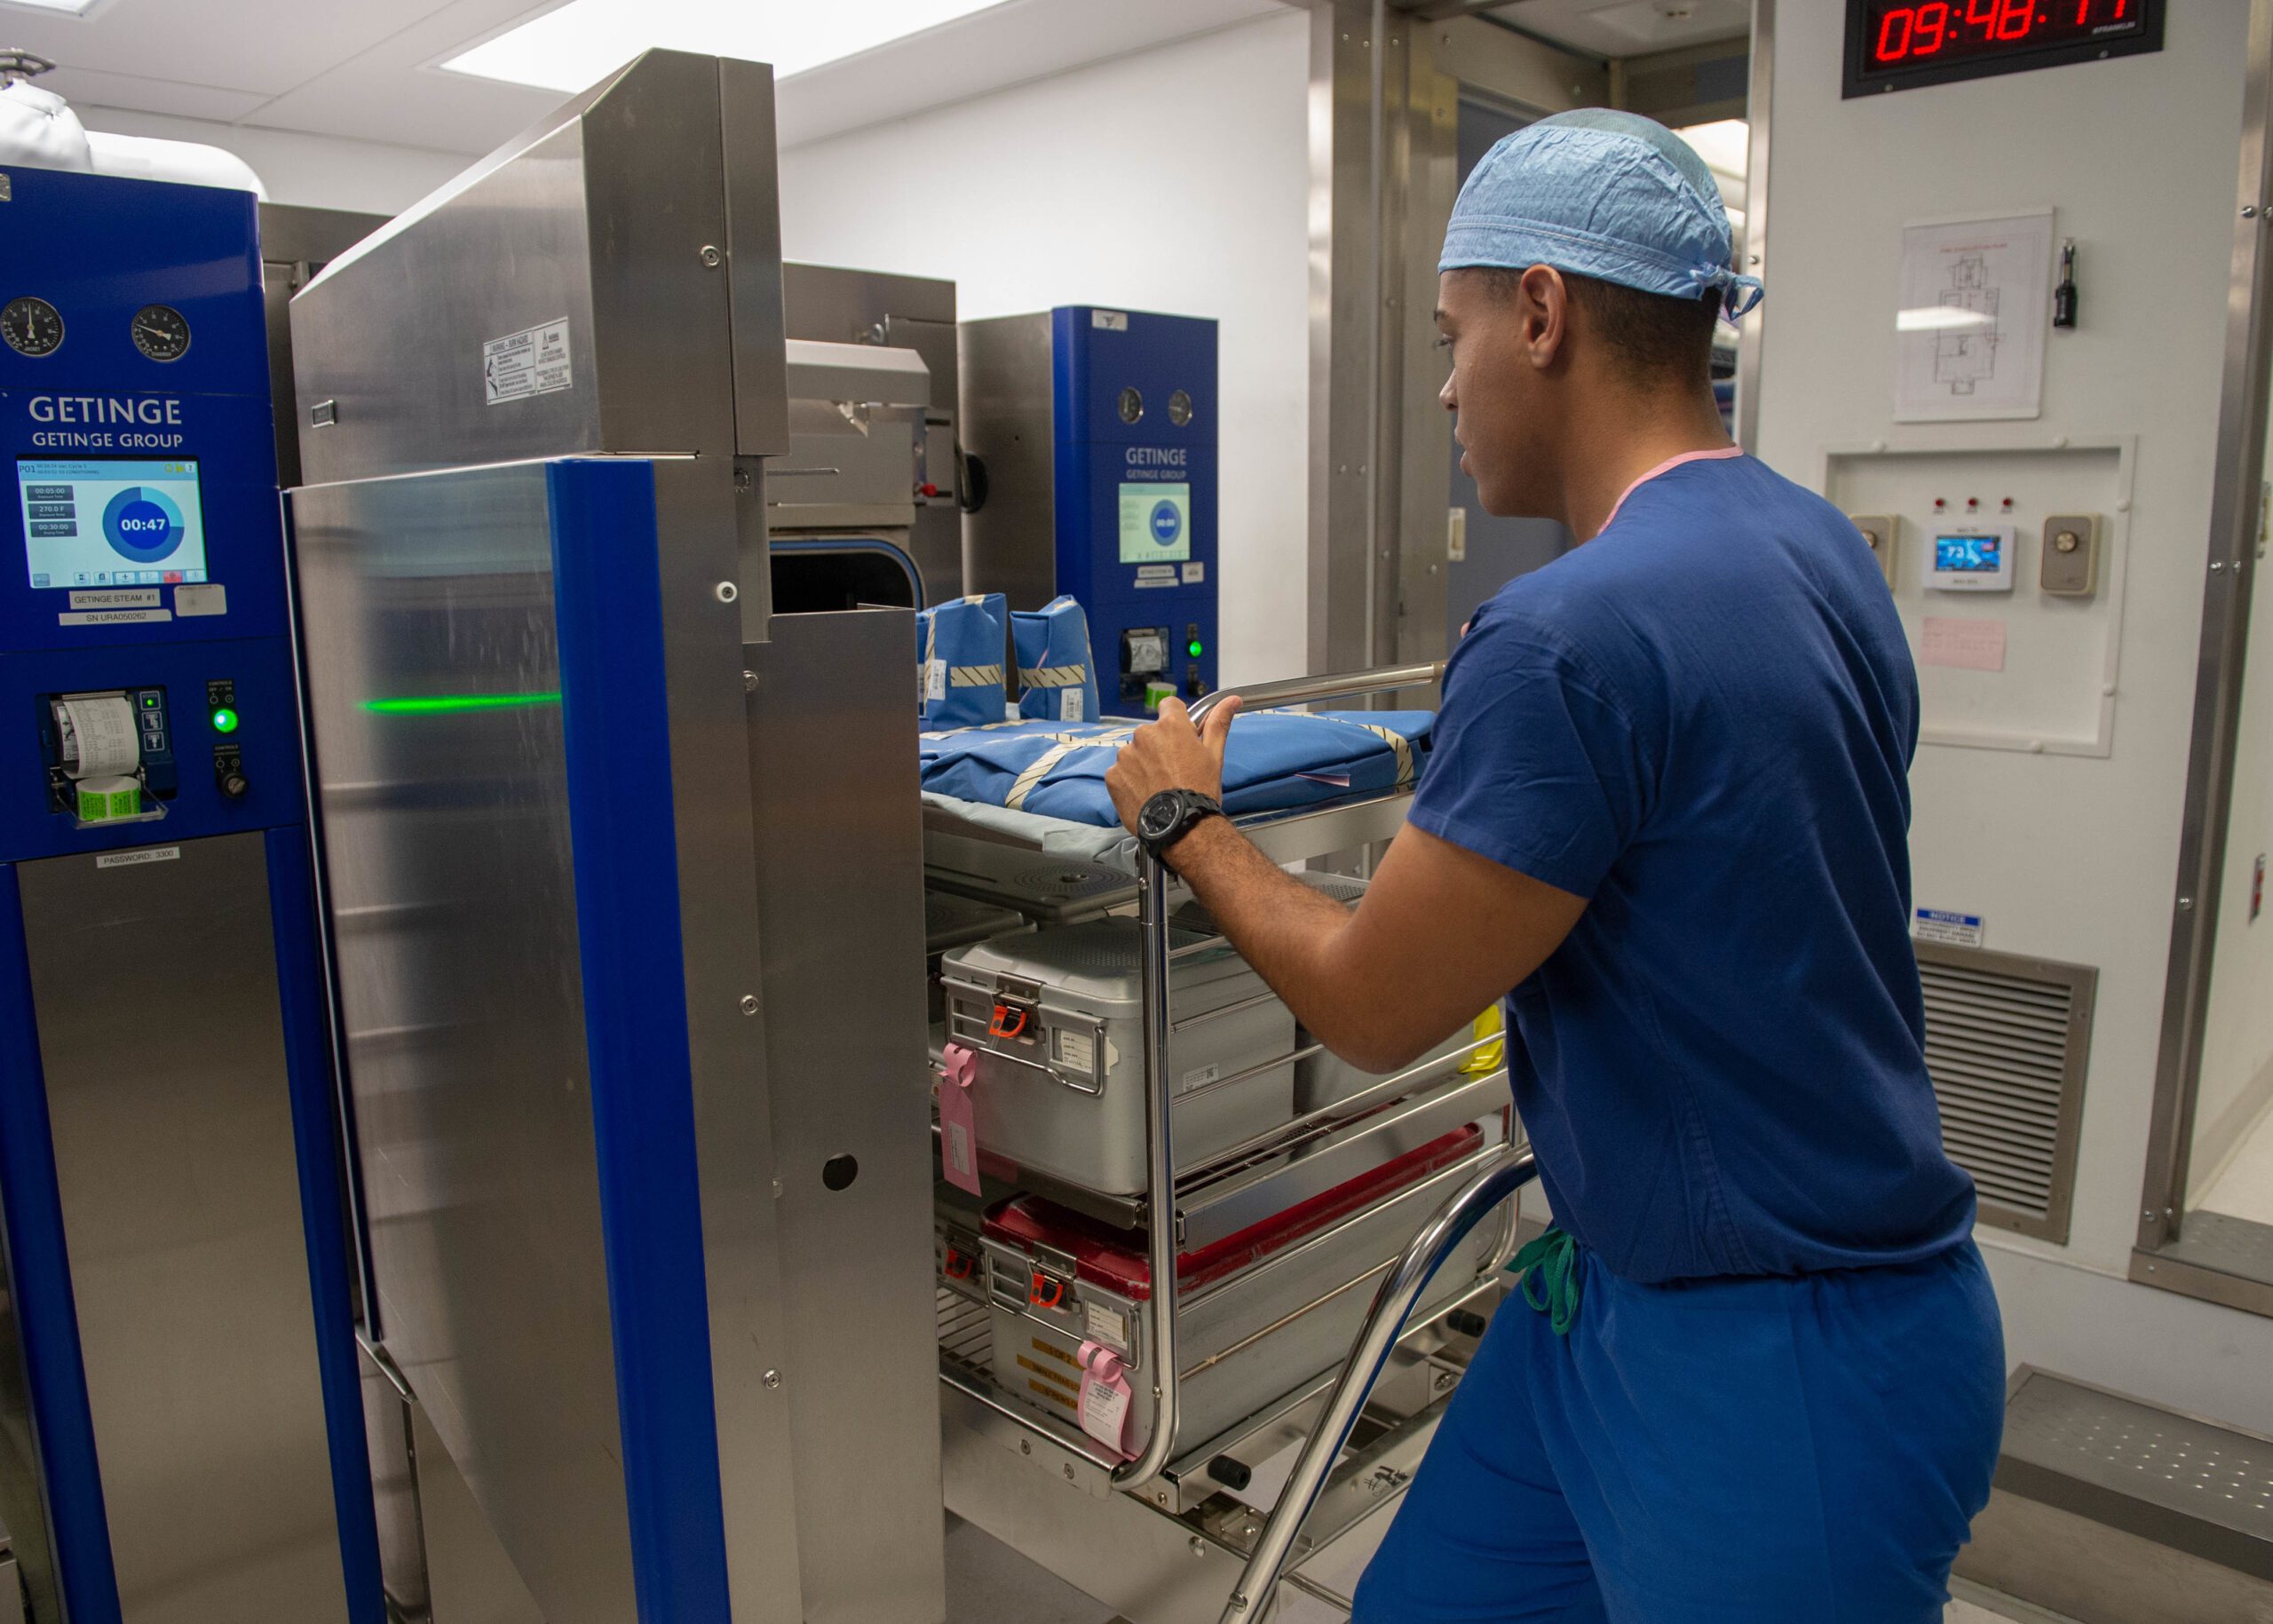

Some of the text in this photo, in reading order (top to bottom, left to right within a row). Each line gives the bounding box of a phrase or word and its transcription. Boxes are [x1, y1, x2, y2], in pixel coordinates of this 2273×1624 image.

[28, 396, 182, 424] GETINGE
[32, 432, 183, 448] GETINGE GROUP
[1125, 447, 1186, 466] GETINGE
[19, 464, 36, 473] P01
[1126, 470, 1186, 479] GETINGE GROUP
[121, 519, 166, 531] 00:47
[104, 850, 174, 864] PASSWORD: 3300
[1930, 911, 1966, 923] NOTICE
